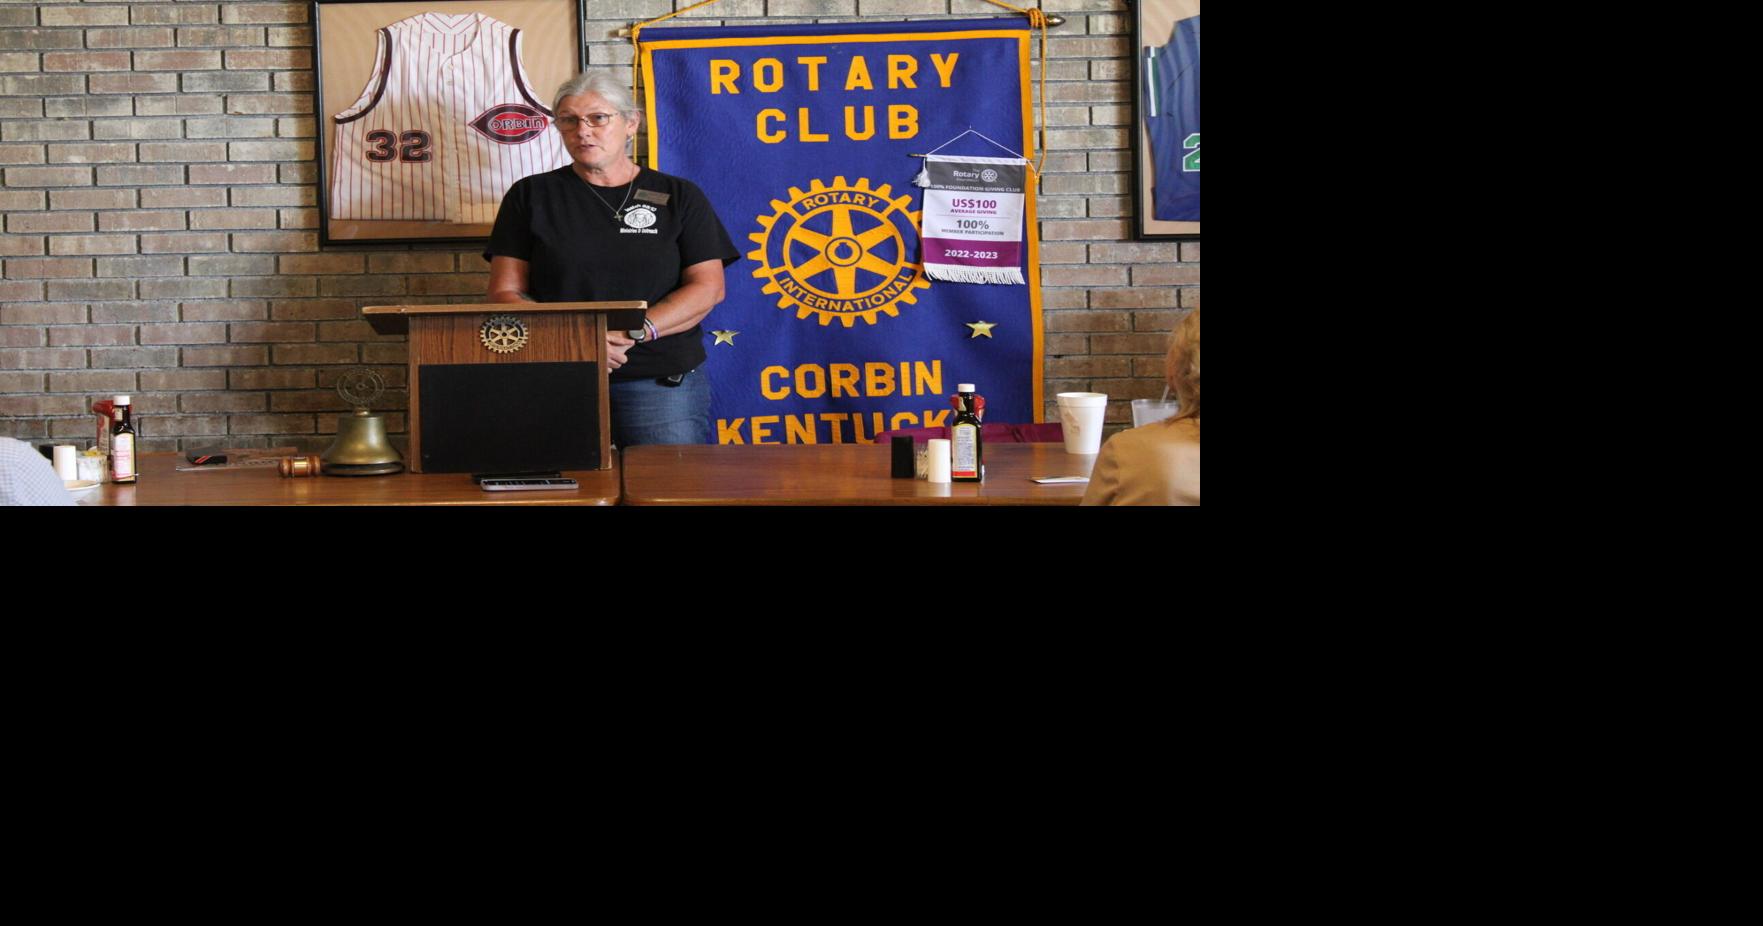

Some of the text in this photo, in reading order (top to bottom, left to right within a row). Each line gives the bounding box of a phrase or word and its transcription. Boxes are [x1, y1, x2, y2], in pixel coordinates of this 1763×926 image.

[709, 52, 959, 95] ROTARY
[756, 104, 919, 144] CLUB
[365, 128, 433, 163] 32
[953, 170, 980, 179] Rotary
[802, 192, 880, 211] ROTARY
[952, 198, 997, 210] US$100
[956, 219, 990, 230] 100%
[944, 249, 998, 260] 2022-2023
[779, 273, 914, 312] INTERNATIONAL
[760, 359, 943, 400] CORBIN
[716, 409, 952, 444] KENTUCK
